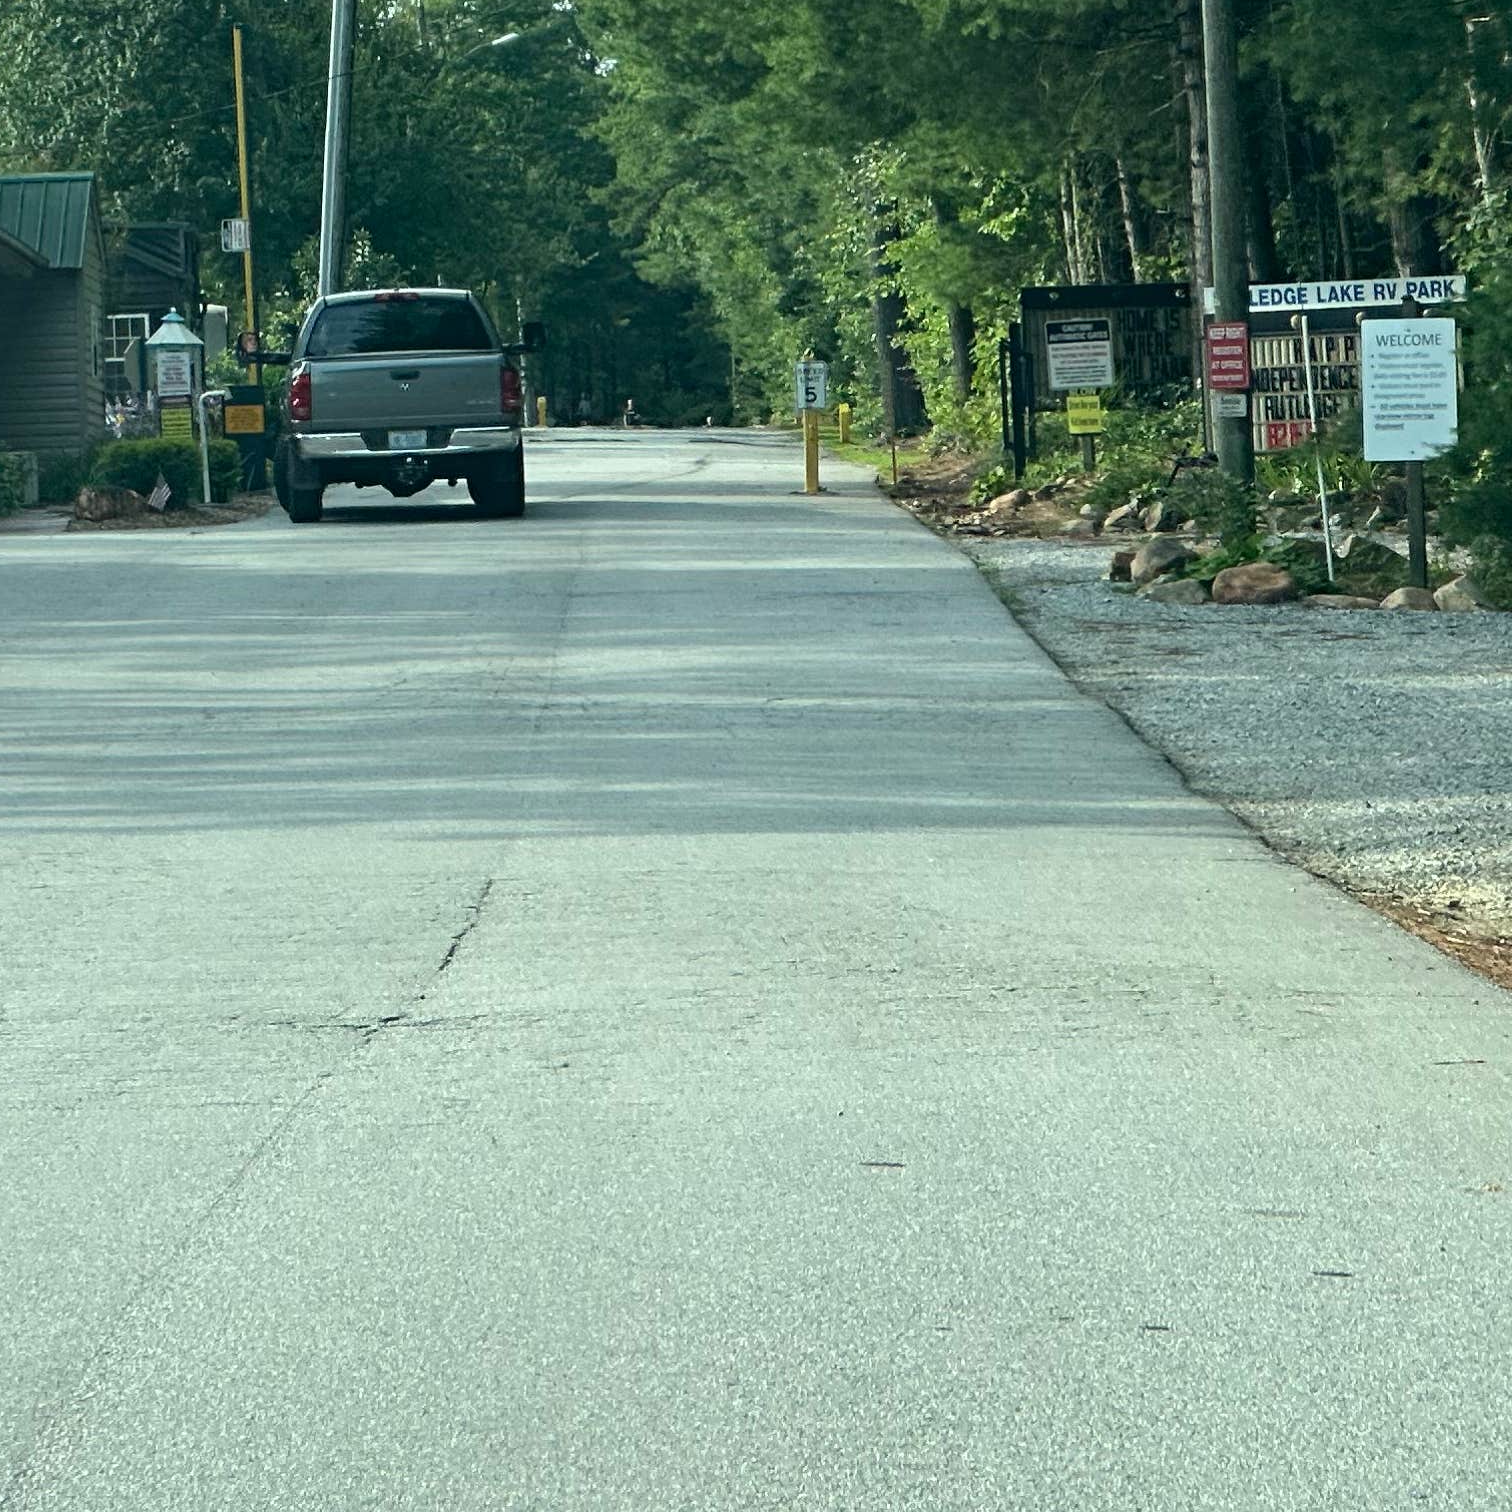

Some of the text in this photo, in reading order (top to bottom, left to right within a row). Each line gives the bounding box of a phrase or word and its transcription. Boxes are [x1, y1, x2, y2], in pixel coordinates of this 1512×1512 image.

[1249, 279, 1455, 307] LEDGE LAKE RV PARK
[1293, 335, 1354, 363] HAPP
[1376, 333, 1443, 347] WELCOME
[1251, 365, 1359, 393] NDEPENDENCE
[805, 387, 817, 402] 5
